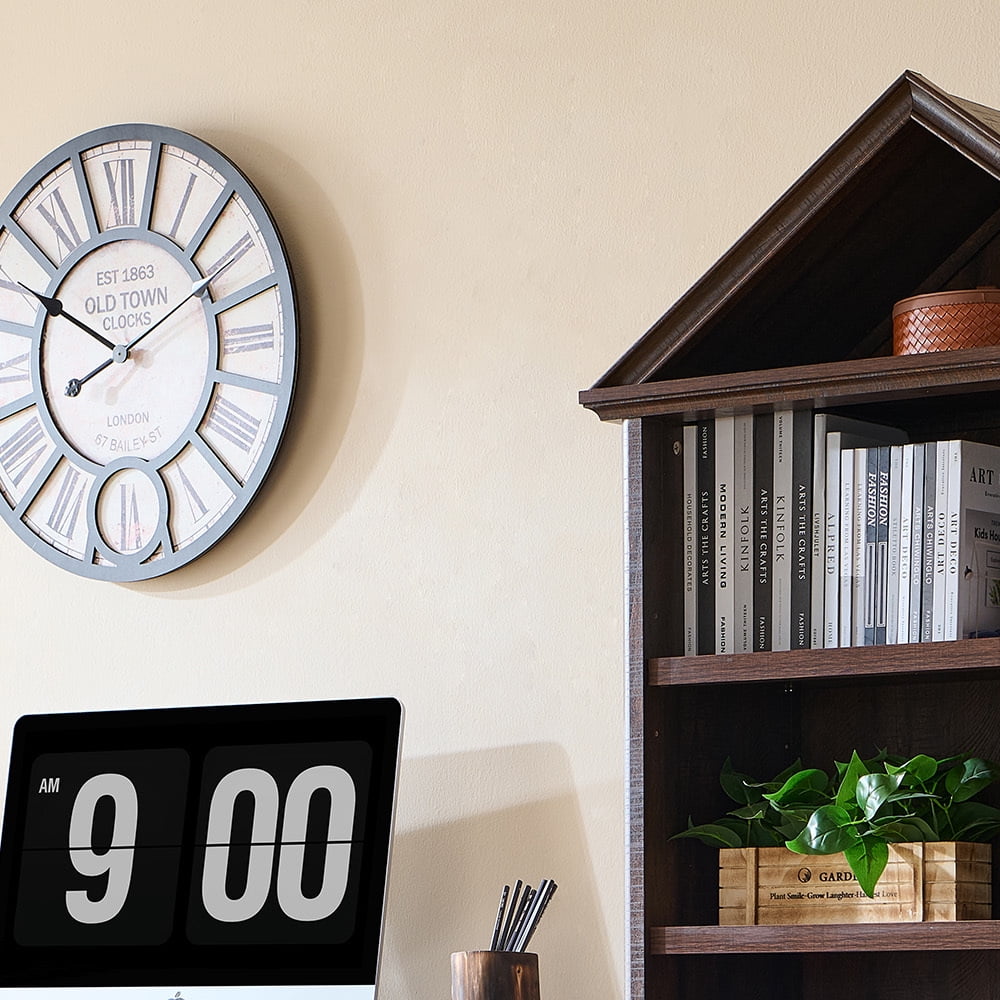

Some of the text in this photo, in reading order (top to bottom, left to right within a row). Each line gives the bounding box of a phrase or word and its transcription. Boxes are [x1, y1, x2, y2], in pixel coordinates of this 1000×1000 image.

[97, 265, 155, 286] EST 1863
[85, 286, 168, 315] OLD TOWN
[103, 311, 152, 331] CLOCKS
[107, 411, 150, 428] LONDON
[94, 426, 163, 452] 67 BAILEY ST
[969, 466, 994, 486] ART
[868, 472, 877, 527] FASHION
[878, 471, 888, 526] FASHION
[776, 495, 785, 562] KINFOLK
[926, 505, 934, 529] ARTS
[740, 505, 749, 572] KINFOLK
[760, 489, 768, 584] ARTS THE CRAFTS
[798, 484, 806, 580] ARTS THE CRAFTS
[937, 513, 945, 576] ART DECO
[974, 527, 988, 540] Kids
[39, 777, 60, 794] AM
[65, 765, 356, 925] 9 00
[770, 892, 786, 900] Plant
